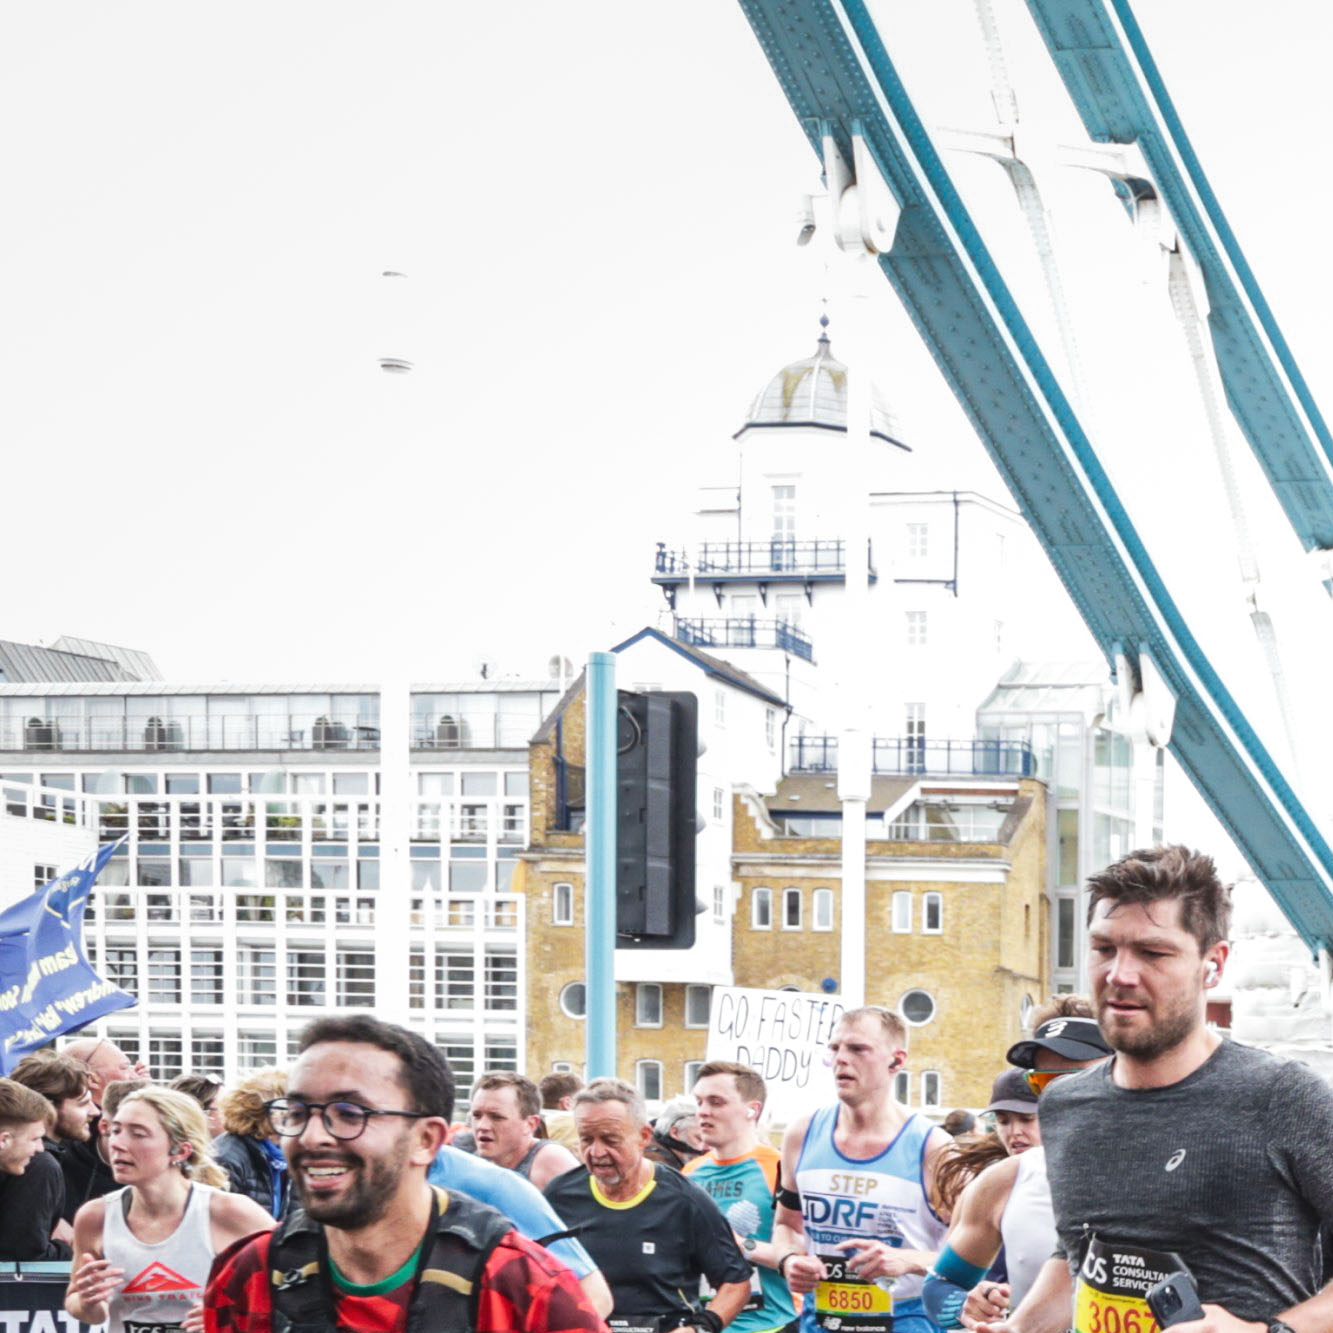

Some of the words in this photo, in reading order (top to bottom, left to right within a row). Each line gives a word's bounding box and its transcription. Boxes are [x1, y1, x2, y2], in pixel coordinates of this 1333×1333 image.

[718, 993, 749, 1041] GO
[736, 1045, 812, 1088] DADDY
[829, 1174, 878, 1195] STEP
[1112, 1253, 1146, 1267] TATA
[828, 1289, 873, 1311] 6850
[856, 1325, 887, 1333] balance
